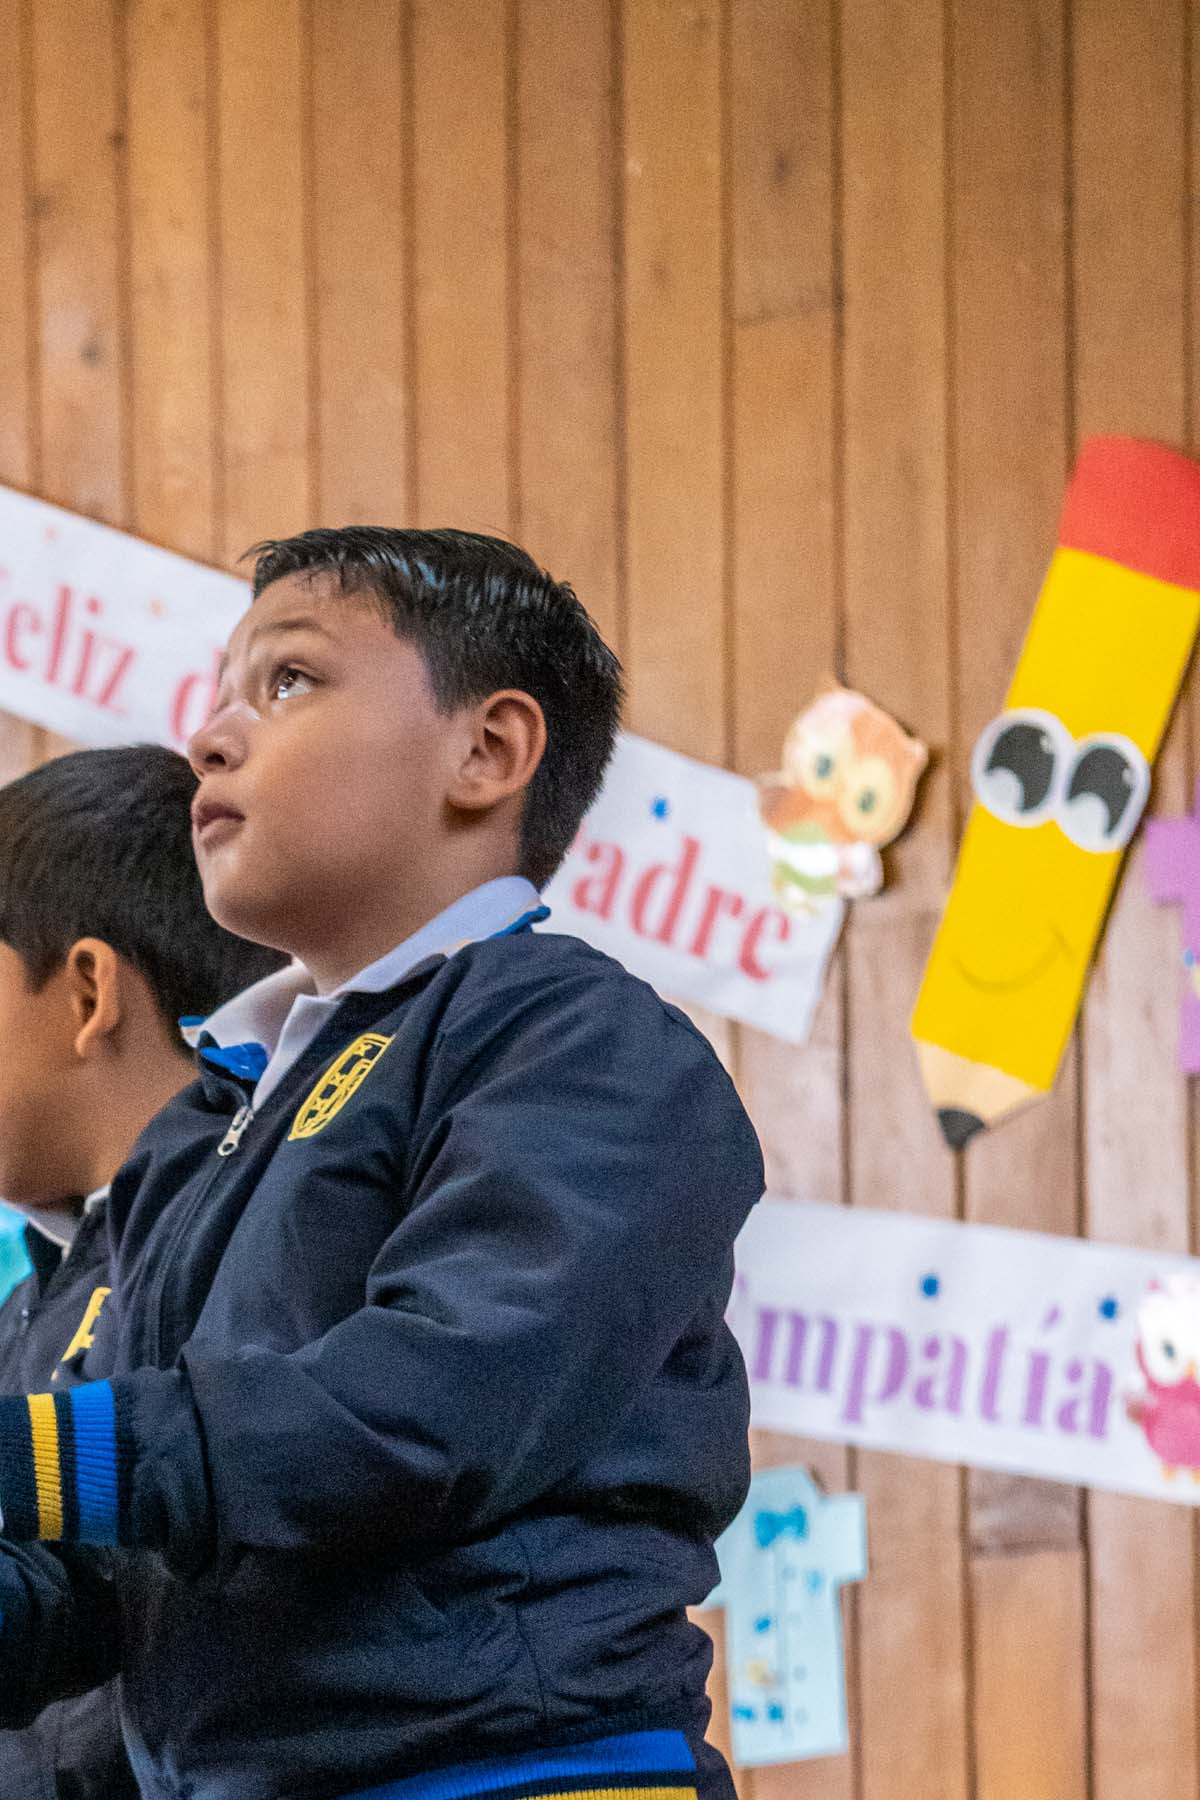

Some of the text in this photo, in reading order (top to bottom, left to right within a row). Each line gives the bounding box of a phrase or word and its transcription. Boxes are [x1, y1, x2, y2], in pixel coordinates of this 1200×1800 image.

[167, 645, 224, 743] d
[571, 822, 793, 984] adre
[737, 1274, 1115, 1440] mpatía
